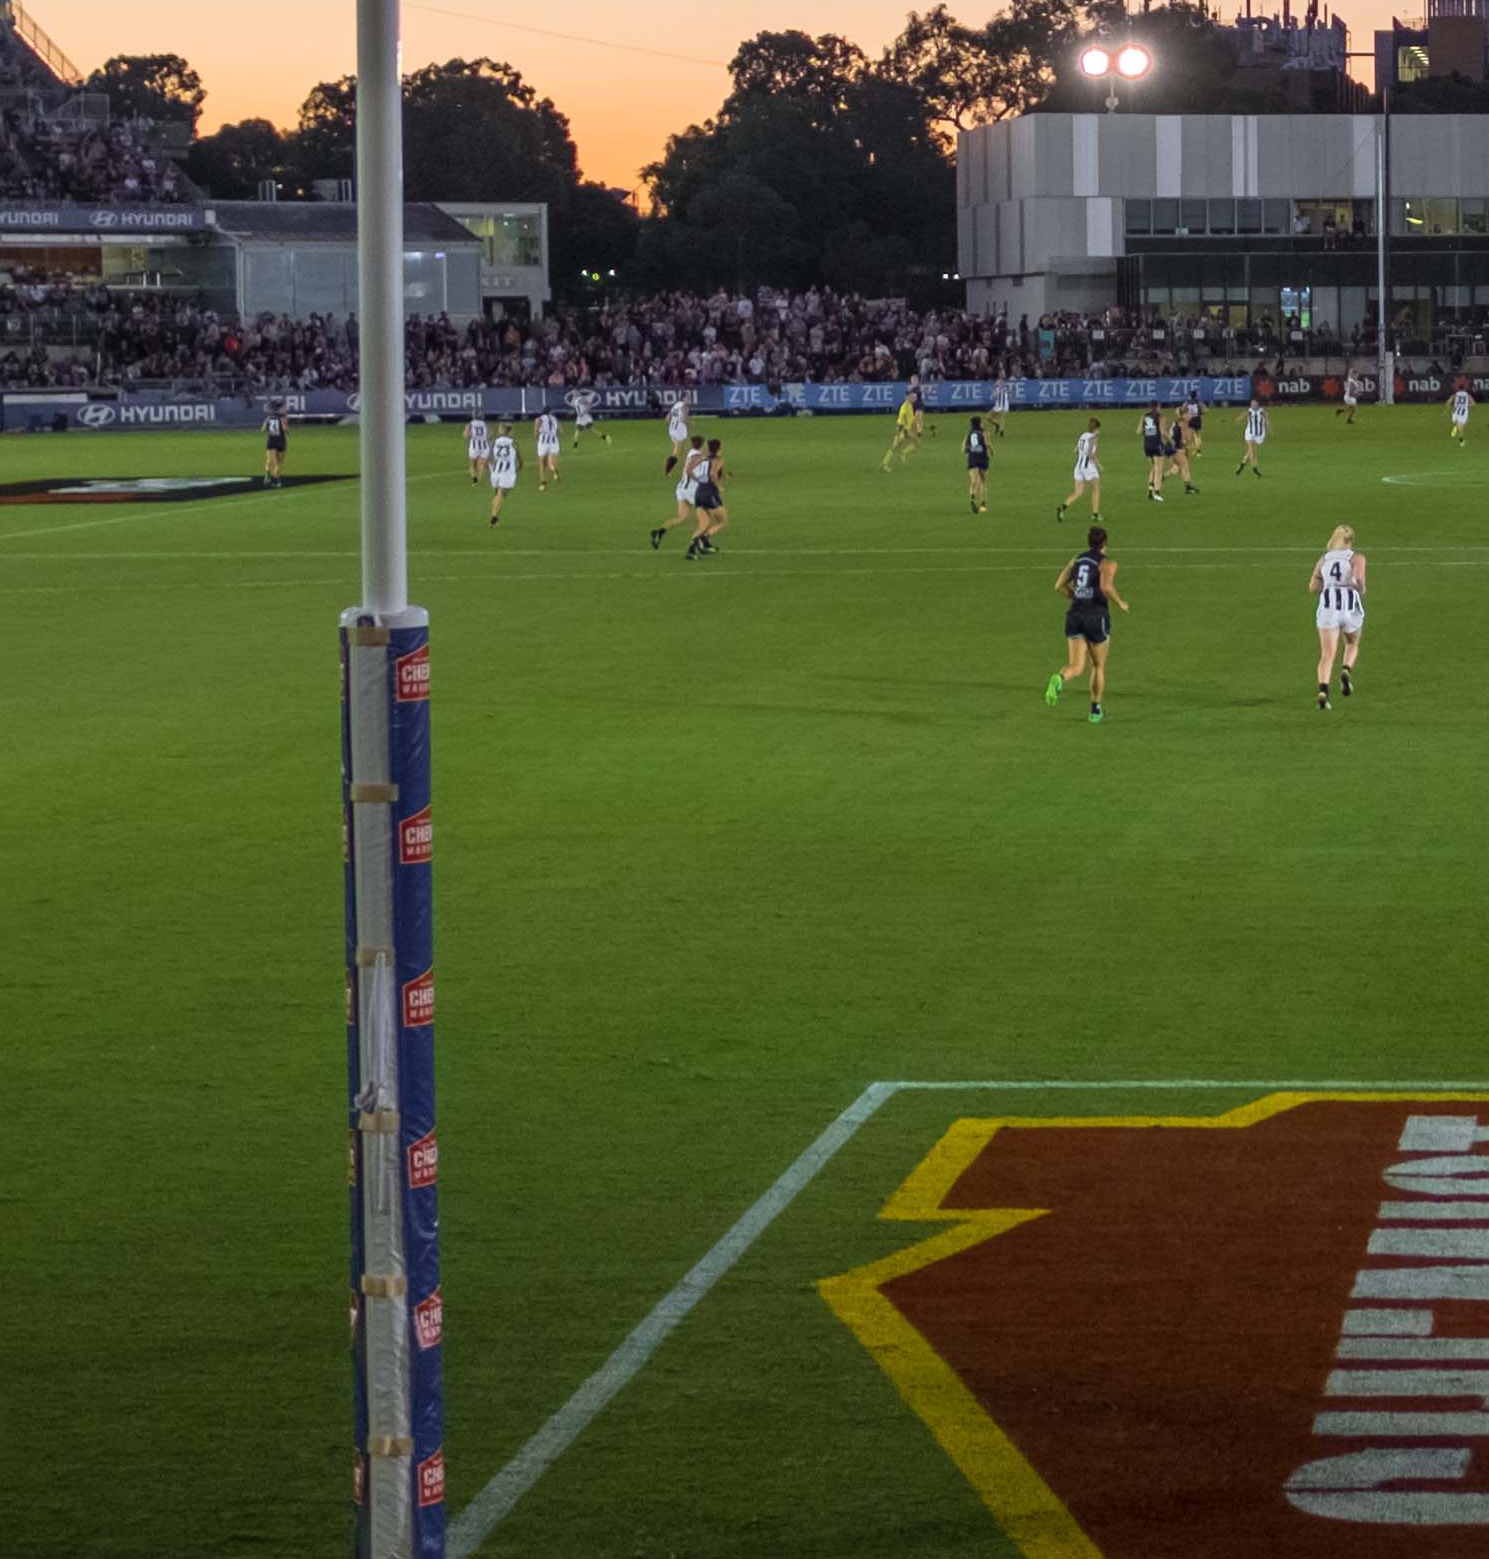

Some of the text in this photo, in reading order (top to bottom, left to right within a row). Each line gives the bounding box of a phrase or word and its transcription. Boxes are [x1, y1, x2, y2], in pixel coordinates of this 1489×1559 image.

[121, 212, 192, 226] HYUNDAI
[863, 385, 893, 401] ZTE
[951, 383, 982, 399] ZTE
[1038, 380, 1069, 397] ZTE
[1083, 380, 1113, 397] ZTE
[1126, 380, 1156, 396] ZTE
[1169, 379, 1200, 395] ZTE
[1214, 378, 1243, 394] ZTE
[1278, 379, 1310, 393] nab
[1409, 378, 1441, 392] nab
[404, 393, 482, 409] YUNDAI
[730, 385, 760, 403] ZTE
[818, 385, 849, 402] ZTE
[121, 404, 215, 423] HYUNDAI
[497, 444, 511, 457] 23
[1076, 565, 1089, 587] 5
[1330, 561, 1341, 581] 4
